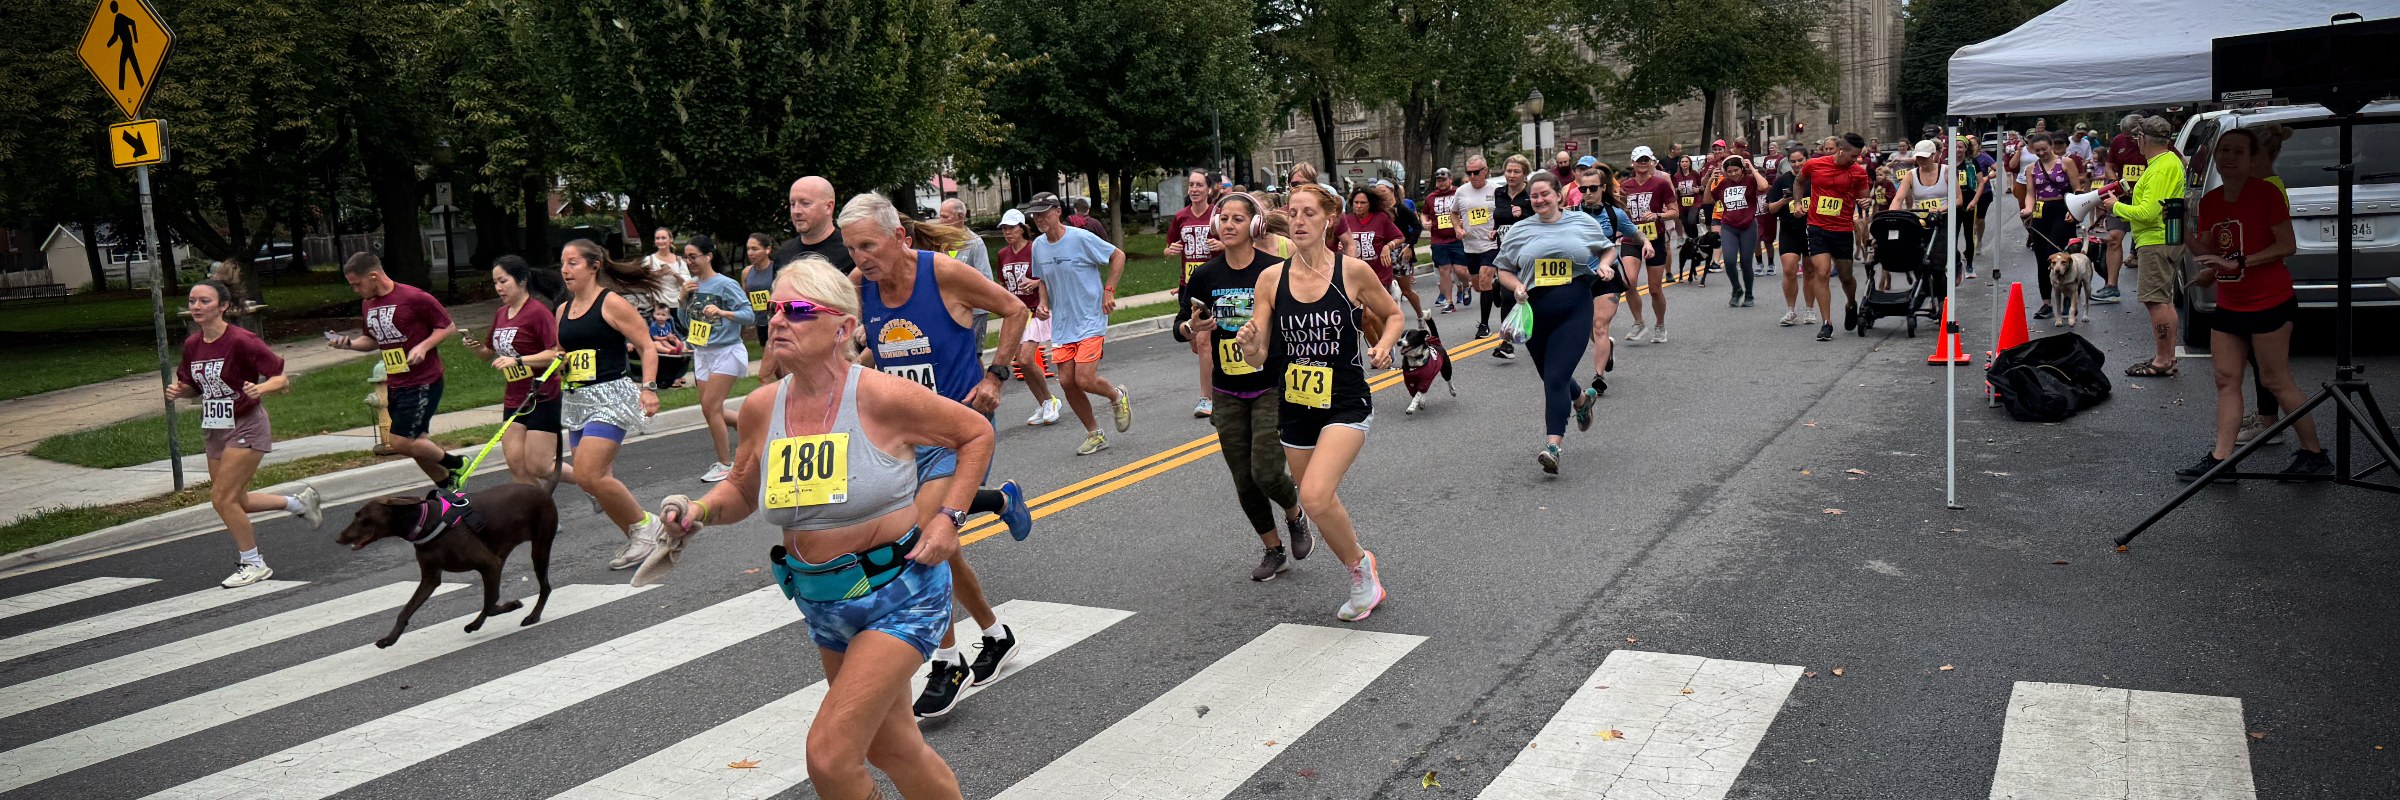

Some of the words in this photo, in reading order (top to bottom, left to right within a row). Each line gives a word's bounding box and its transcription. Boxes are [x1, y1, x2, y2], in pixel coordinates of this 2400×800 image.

[2126, 166, 2141, 176] 181
[1724, 187, 1743, 198] 1492
[1822, 198, 1839, 211] 140
[1471, 209, 1487, 221] 152
[1638, 226, 1654, 236] 41
[1541, 261, 1567, 276] 108
[751, 293, 767, 304] 189
[367, 306, 404, 341] 5K
[1280, 310, 1342, 331] LIVING
[692, 323, 707, 338] 178
[1284, 326, 1346, 343] KIDNEY
[910, 346, 932, 356] CLUB
[1222, 342, 1243, 363] 18
[1287, 341, 1340, 356] DONOR
[385, 352, 404, 366] 110
[505, 364, 528, 381] 109
[191, 361, 235, 401] 5K
[1291, 368, 1324, 395] 173
[204, 401, 234, 419] 1505
[779, 440, 835, 484] 180
